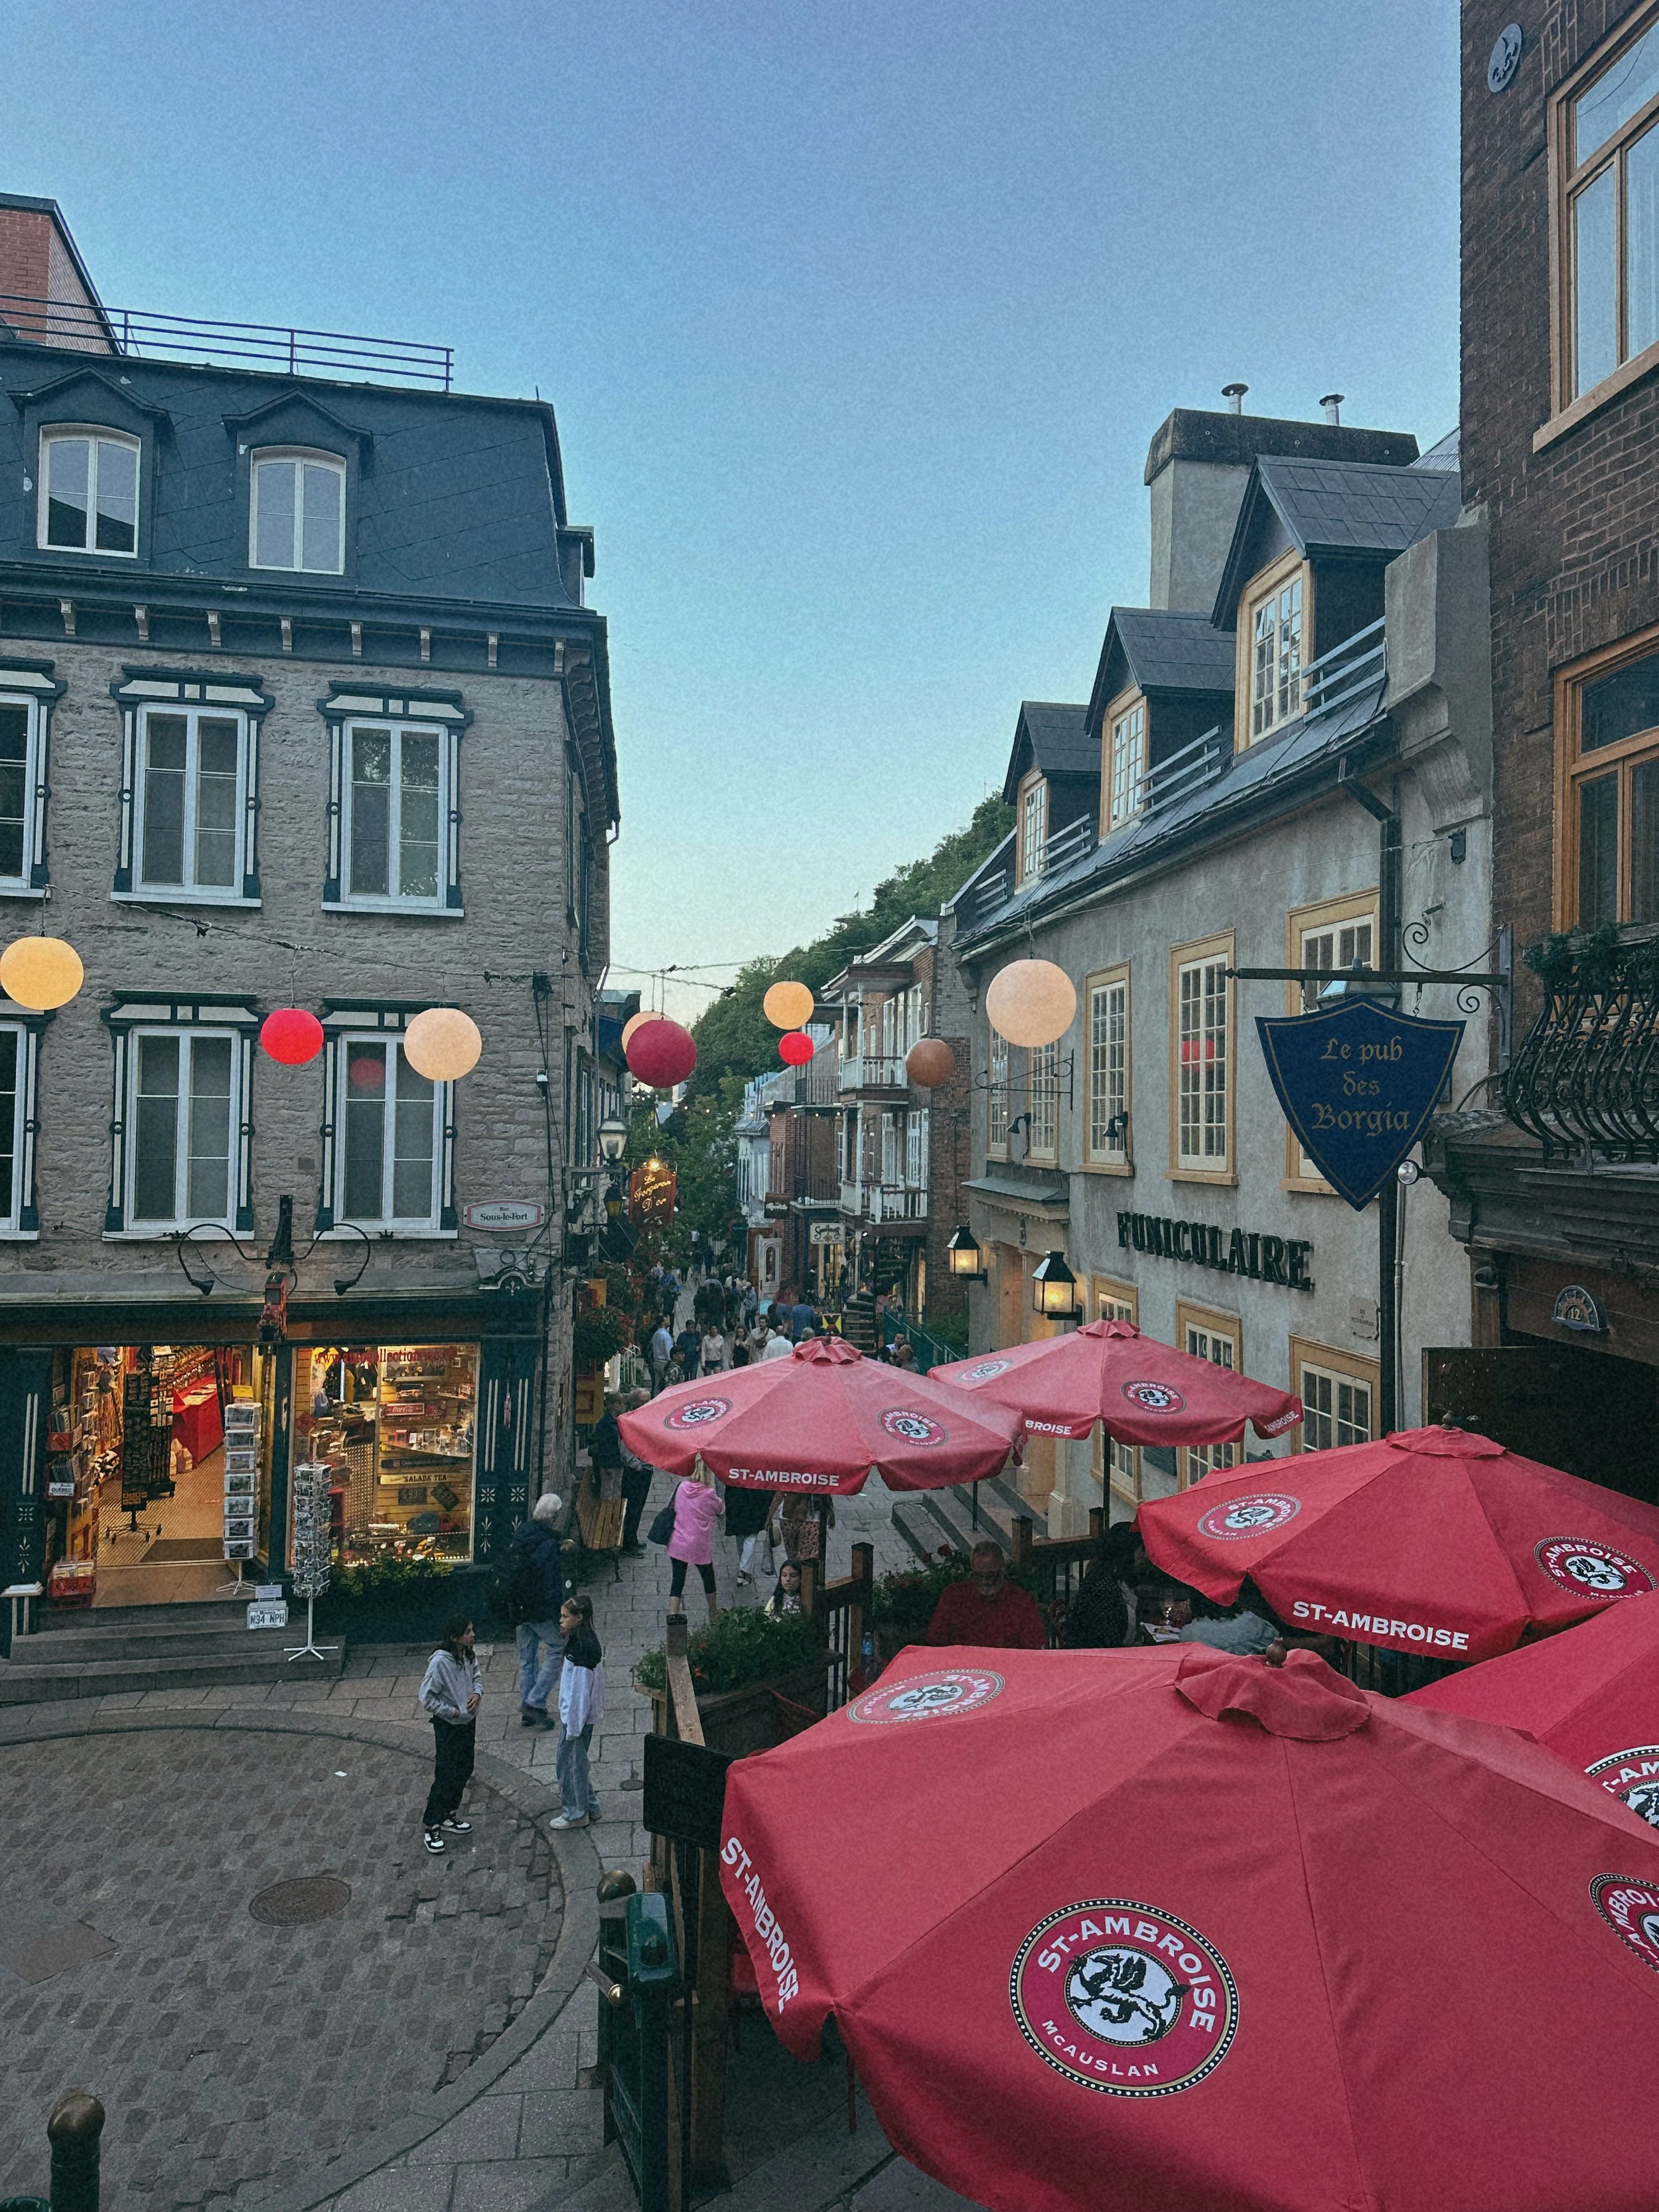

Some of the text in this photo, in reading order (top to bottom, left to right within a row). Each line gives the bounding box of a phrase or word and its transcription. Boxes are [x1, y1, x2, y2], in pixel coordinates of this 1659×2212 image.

[1321, 1035, 1403, 1065] Le pub
[1343, 1070, 1380, 1096] des
[1311, 1101, 1410, 1136] Borgia
[1116, 1210, 1311, 1291] FUNICULAIRE
[1571, 1308, 1581, 1320] 12
[1127, 1382, 1179, 1399] ST-AMBROISE
[883, 1411, 938, 1432] ST-AMBROISE
[1025, 1419, 1072, 1435] BROISE
[728, 1468, 840, 1487] ST-AMBROISE
[1228, 1498, 1291, 1528] ST-AMBROISE
[1546, 1543, 1638, 1578] ST-AMBROISE
[250, 1613, 285, 1625] N34 NPH
[1293, 1601, 1469, 1651] ST-AMBROISE
[893, 1674, 990, 1720] ST-AMBROISE
[721, 1836, 799, 2015] ST-AMBROISE
[1038, 1916, 1216, 2033] ST-AMBROISE
